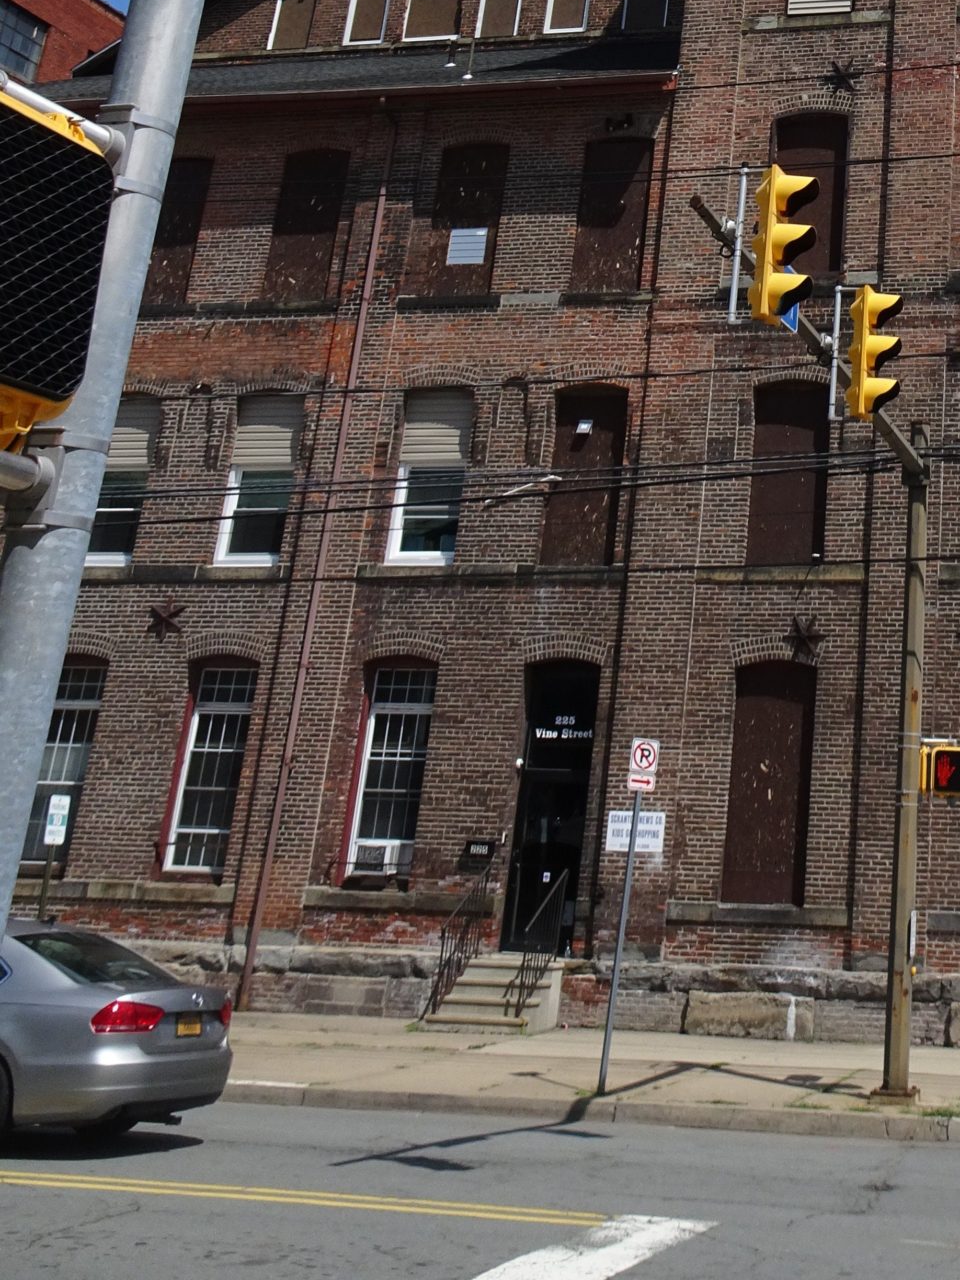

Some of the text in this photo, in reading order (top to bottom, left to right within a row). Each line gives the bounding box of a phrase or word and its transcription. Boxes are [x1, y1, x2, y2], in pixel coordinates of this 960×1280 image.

[554, 715, 576, 725] 225
[535, 728, 594, 739] Vine Street
